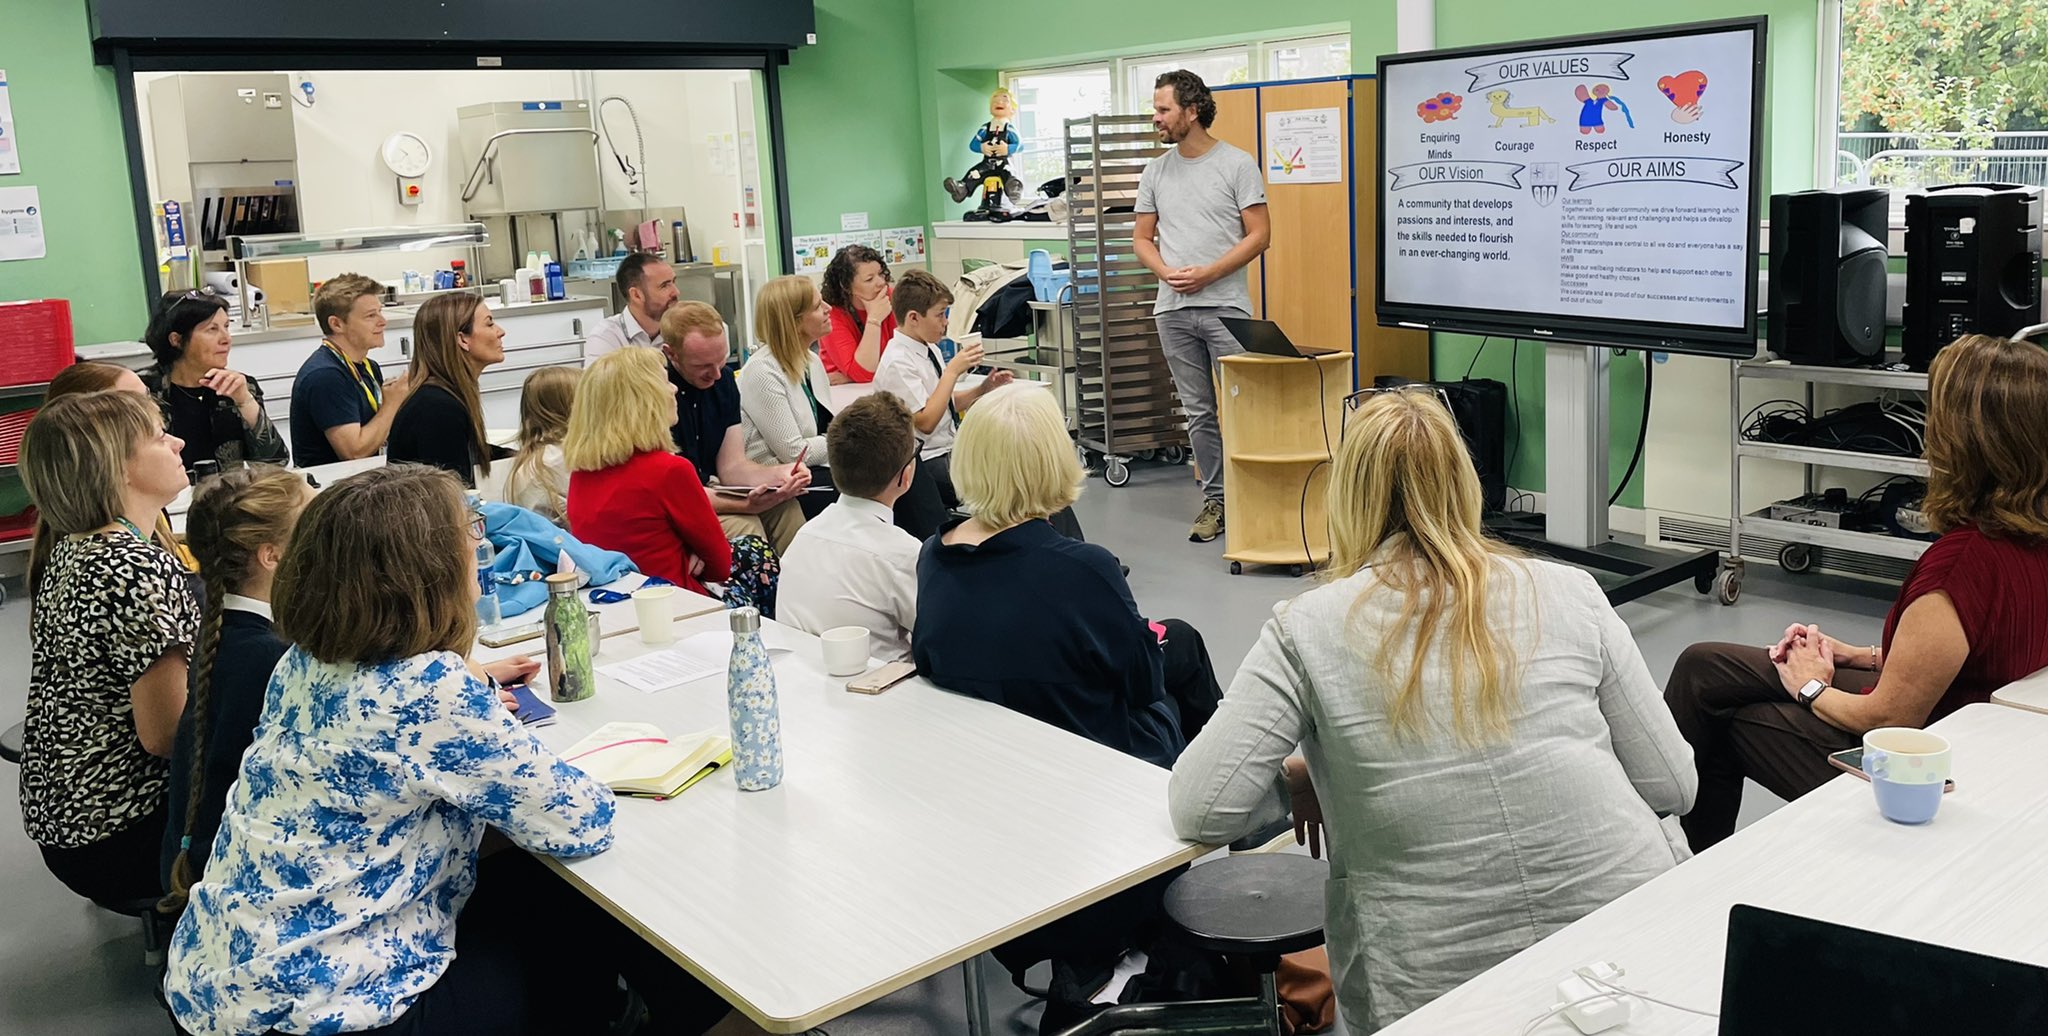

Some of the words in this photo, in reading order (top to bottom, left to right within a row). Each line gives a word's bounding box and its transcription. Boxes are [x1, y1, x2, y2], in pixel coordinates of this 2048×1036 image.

[1499, 63, 1529, 80] OUR
[1532, 57, 1589, 77] VALUES
[1420, 131, 1461, 146] Enquiring
[1664, 130, 1711, 146] Honesty
[1495, 140, 1535, 153] Courage
[1575, 139, 1617, 153] Respect
[1427, 149, 1453, 160] Minds
[1419, 167, 1446, 180] OUR
[1449, 166, 1484, 180] Vision
[1607, 162, 1642, 178] OUR
[1646, 161, 1686, 177] AIMS
[1398, 199, 1404, 208] A
[1406, 199, 1452, 210] community
[1454, 199, 1471, 209] that
[1472, 199, 1513, 210] develops
[1561, 197, 1571, 205] Our
[1675, 206, 1697, 214] forward
[1698, 207, 1721, 215] learning
[1397, 216, 1433, 226] passions
[1435, 216, 1451, 225] and
[1453, 216, 1493, 227] interests,
[1496, 216, 1514, 226] and
[1639, 215, 1670, 223] challenging
[1397, 232, 1410, 241] the
[1412, 232, 1433, 241] skills
[1435, 232, 1467, 242] needed
[1468, 234, 1477, 242] to
[1479, 233, 1514, 244] flourish
[1561, 230, 1571, 239] Our
[1571, 231, 1599, 239] community
[1561, 238, 1581, 246] Positive
[1399, 247, 1407, 256] in
[1408, 248, 1419, 257] an
[1420, 248, 1480, 262] ever-changing
[1483, 250, 1511, 261] world.
[1590, 265, 1614, 273] wellbeing
[1648, 267, 1659, 275] help
[1672, 268, 1694, 276] support
[1560, 279, 1588, 287] Successes
[1600, 274, 1618, 282] healthy
[1614, 291, 1629, 299] proud
[1689, 296, 1729, 304] achievements
